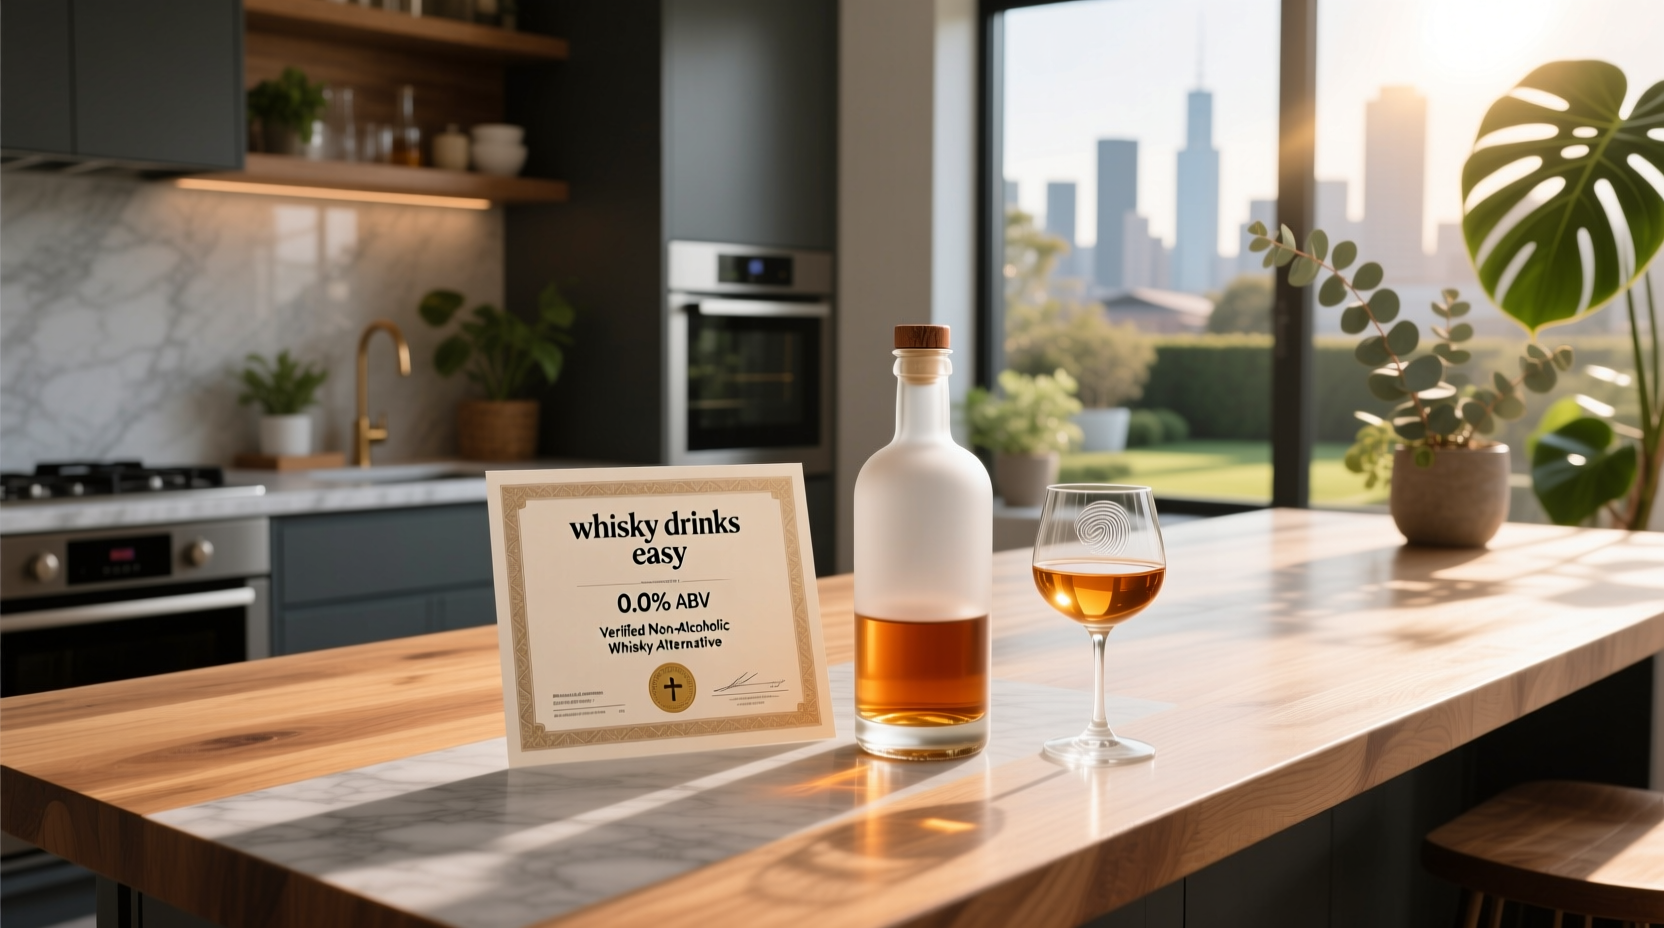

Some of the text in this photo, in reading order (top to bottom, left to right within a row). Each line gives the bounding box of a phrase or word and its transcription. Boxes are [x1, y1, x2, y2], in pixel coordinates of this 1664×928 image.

[569, 509, 741, 544] whisky drinks
[632, 546, 688, 570] easy
[617, 592, 711, 613] 0.0% ABV
[648, 618, 730, 636] Non-Alcoholic
[608, 636, 722, 656] Whisky Alternative
